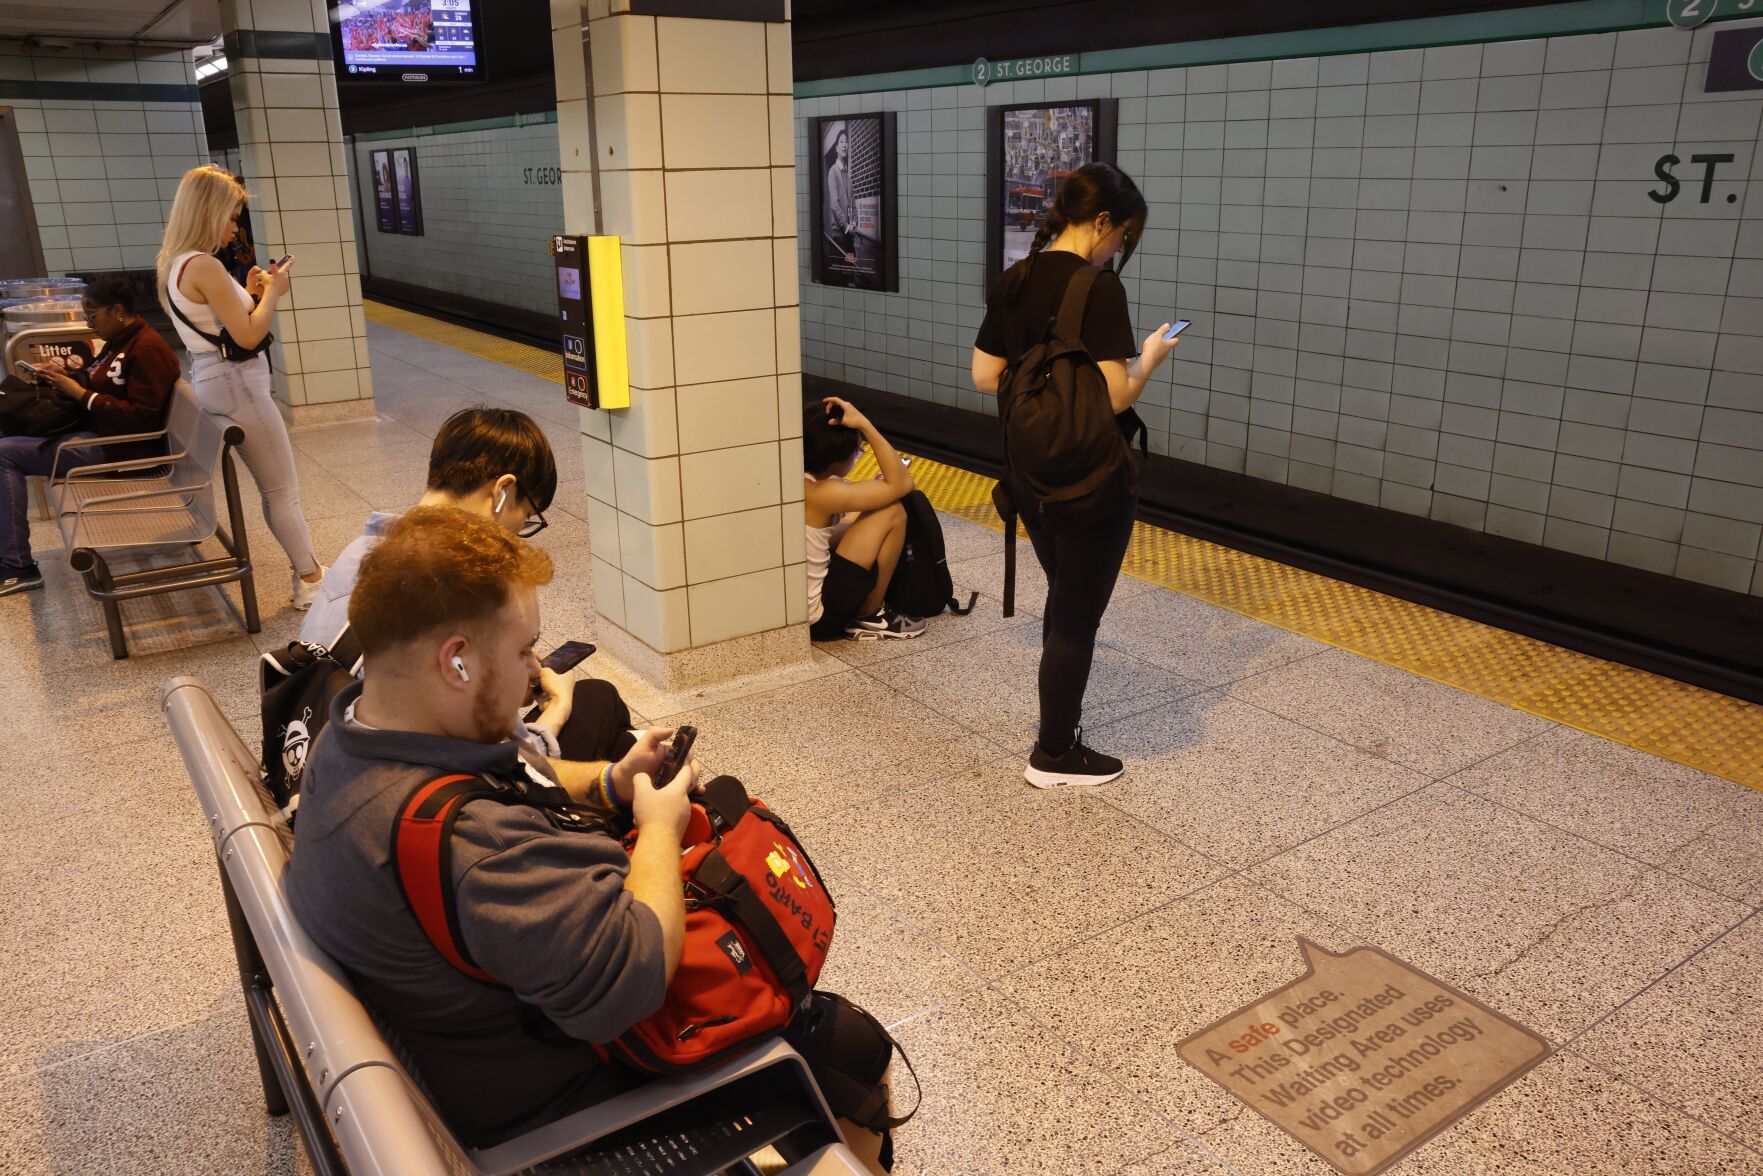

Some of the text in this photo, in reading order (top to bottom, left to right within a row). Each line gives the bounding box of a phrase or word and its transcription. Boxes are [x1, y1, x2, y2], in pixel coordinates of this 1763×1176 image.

[977, 56, 1071, 80] 2 ST. GEORGE
[523, 168, 535, 185] ST.
[1647, 153, 1737, 204] ST.
[39, 344, 73, 357] Litter
[568, 387, 588, 400] Emergency
[764, 871, 813, 931] BARTO
[1205, 991, 1345, 1067] A safe place.
[1230, 984, 1407, 1086] This Designated
[1261, 994, 1454, 1109] Waiting Area uses
[1299, 1017, 1483, 1131] video technology
[1334, 1074, 1462, 1157] at all times.
